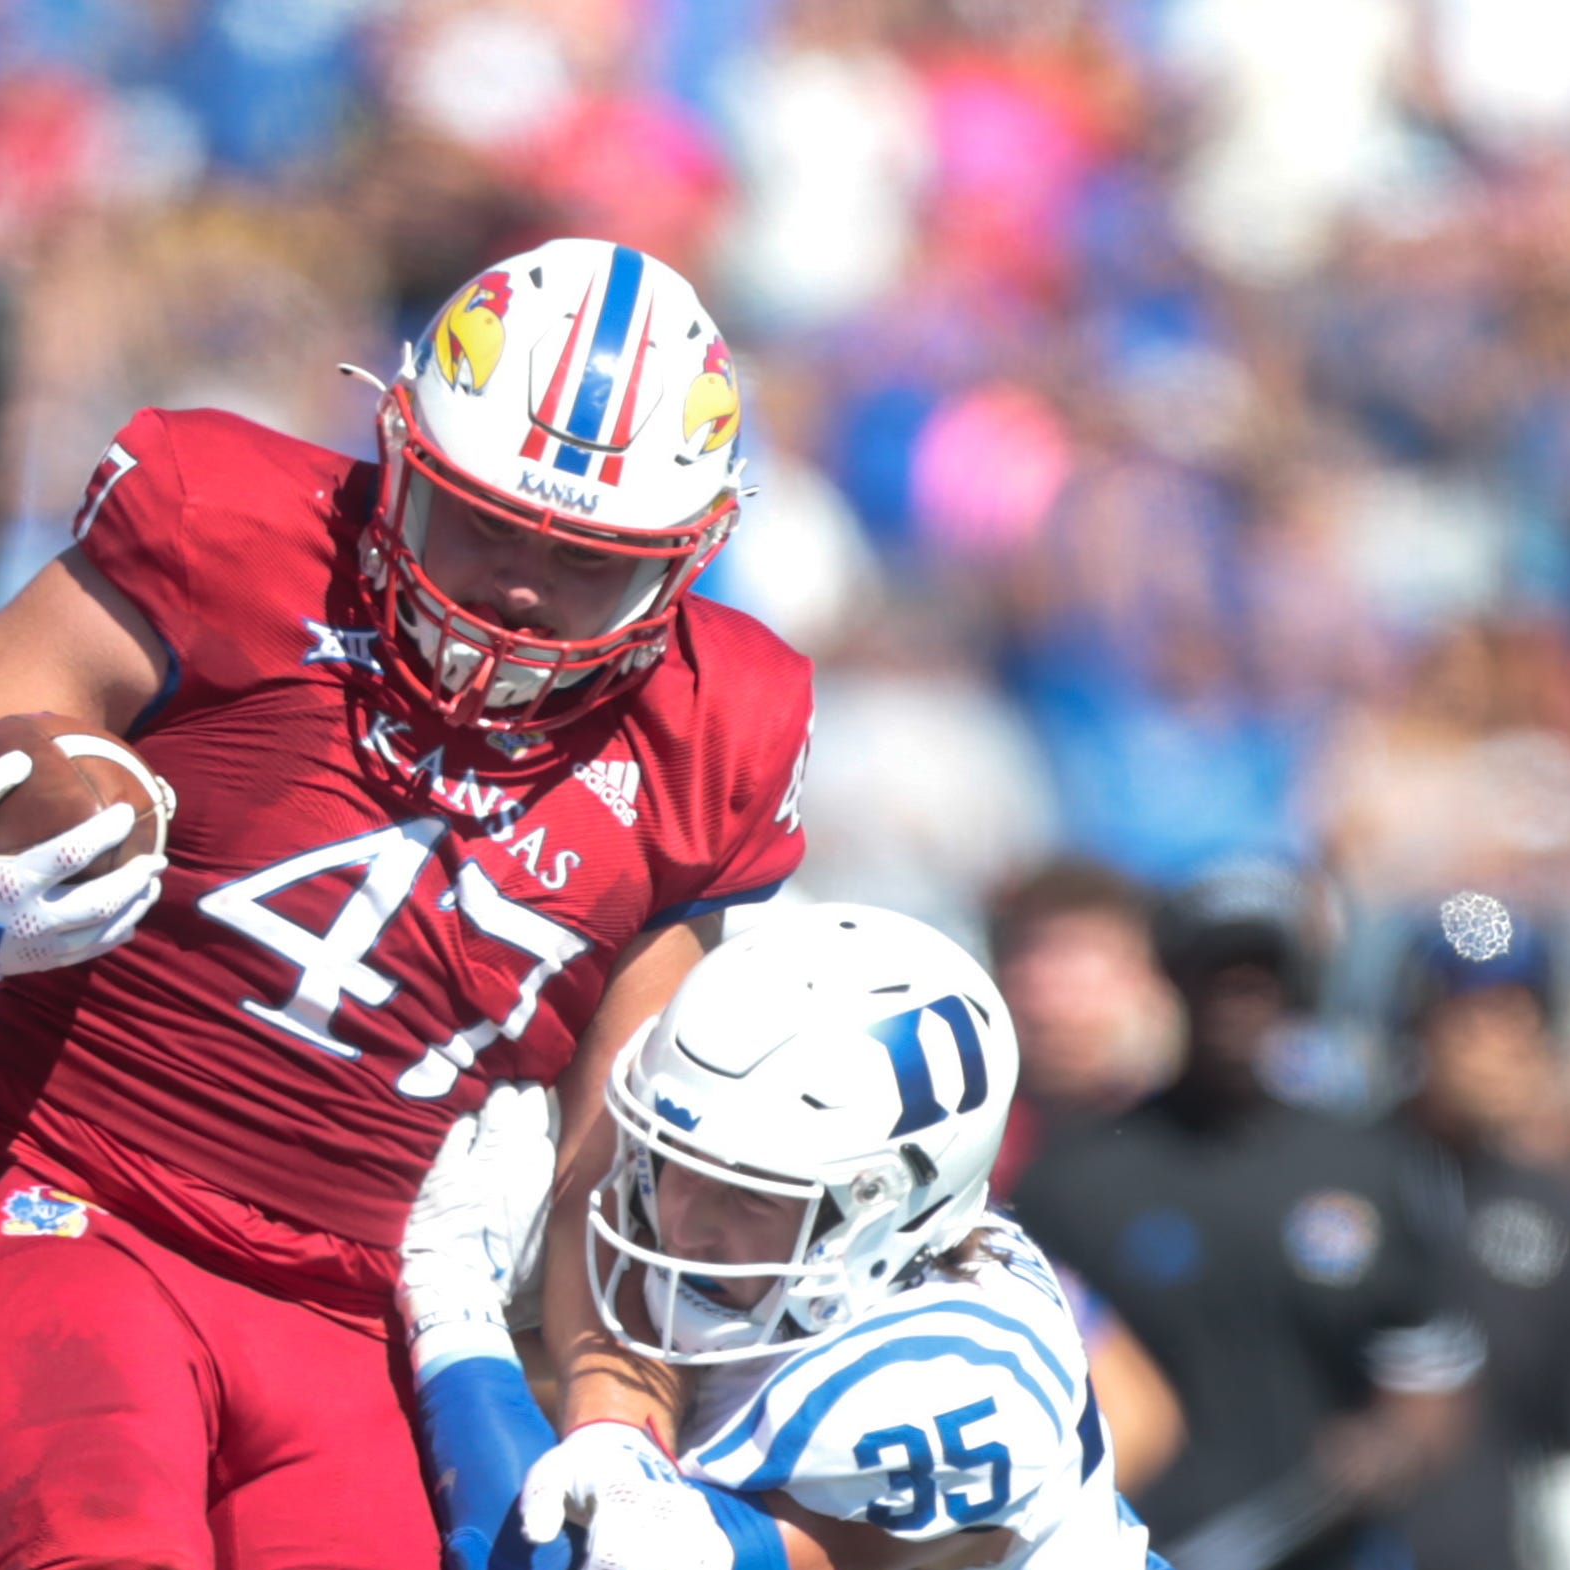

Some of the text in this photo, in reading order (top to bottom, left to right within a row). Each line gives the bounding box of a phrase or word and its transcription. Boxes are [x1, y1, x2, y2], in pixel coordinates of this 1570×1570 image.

[517, 470, 600, 515] KANSAS
[359, 710, 582, 890] KANSAS
[573, 761, 640, 828] adidas
[195, 814, 594, 1099] 47
[864, 994, 988, 1141] D
[852, 1395, 1012, 1532] 35
